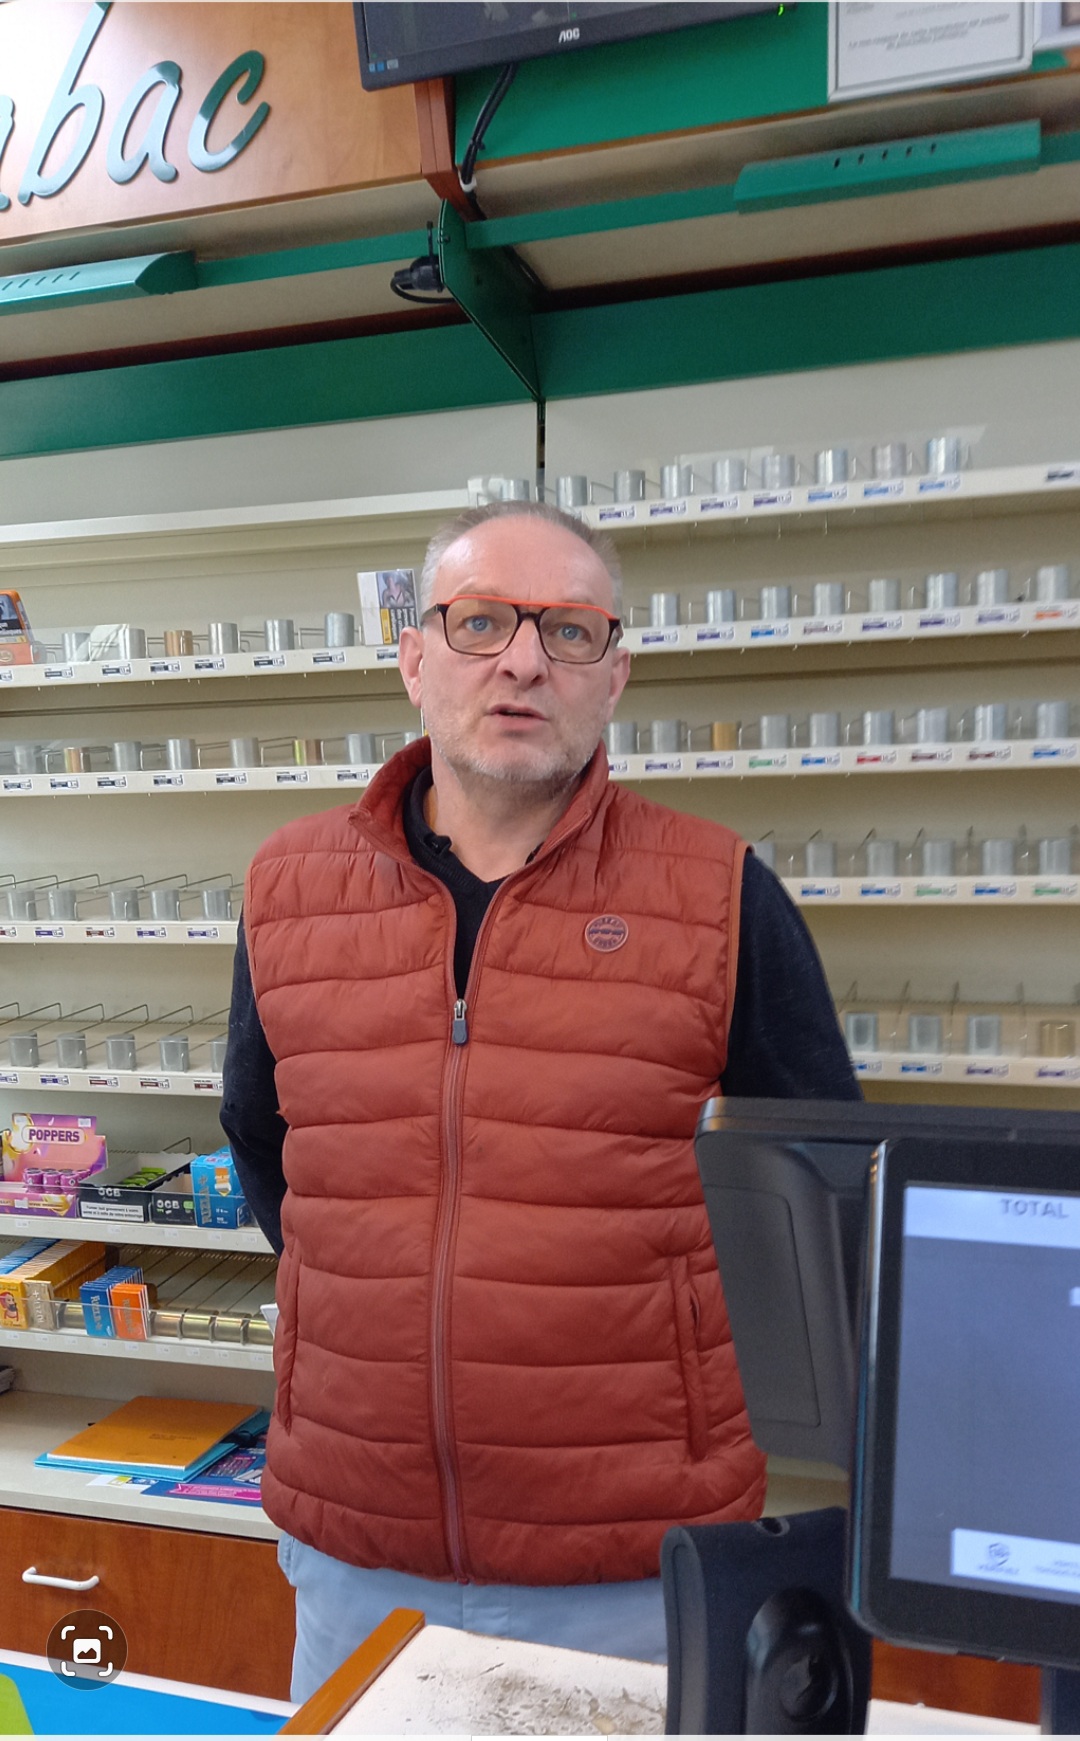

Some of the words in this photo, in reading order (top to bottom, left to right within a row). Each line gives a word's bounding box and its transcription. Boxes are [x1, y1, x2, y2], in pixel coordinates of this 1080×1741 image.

[0, 2, 270, 211] bac
[29, 1129, 80, 1142] POPPERS
[98, 1188, 121, 1197] OCB
[156, 1200, 180, 1209] OCB
[1000, 1199, 1070, 1218] TOTAL
